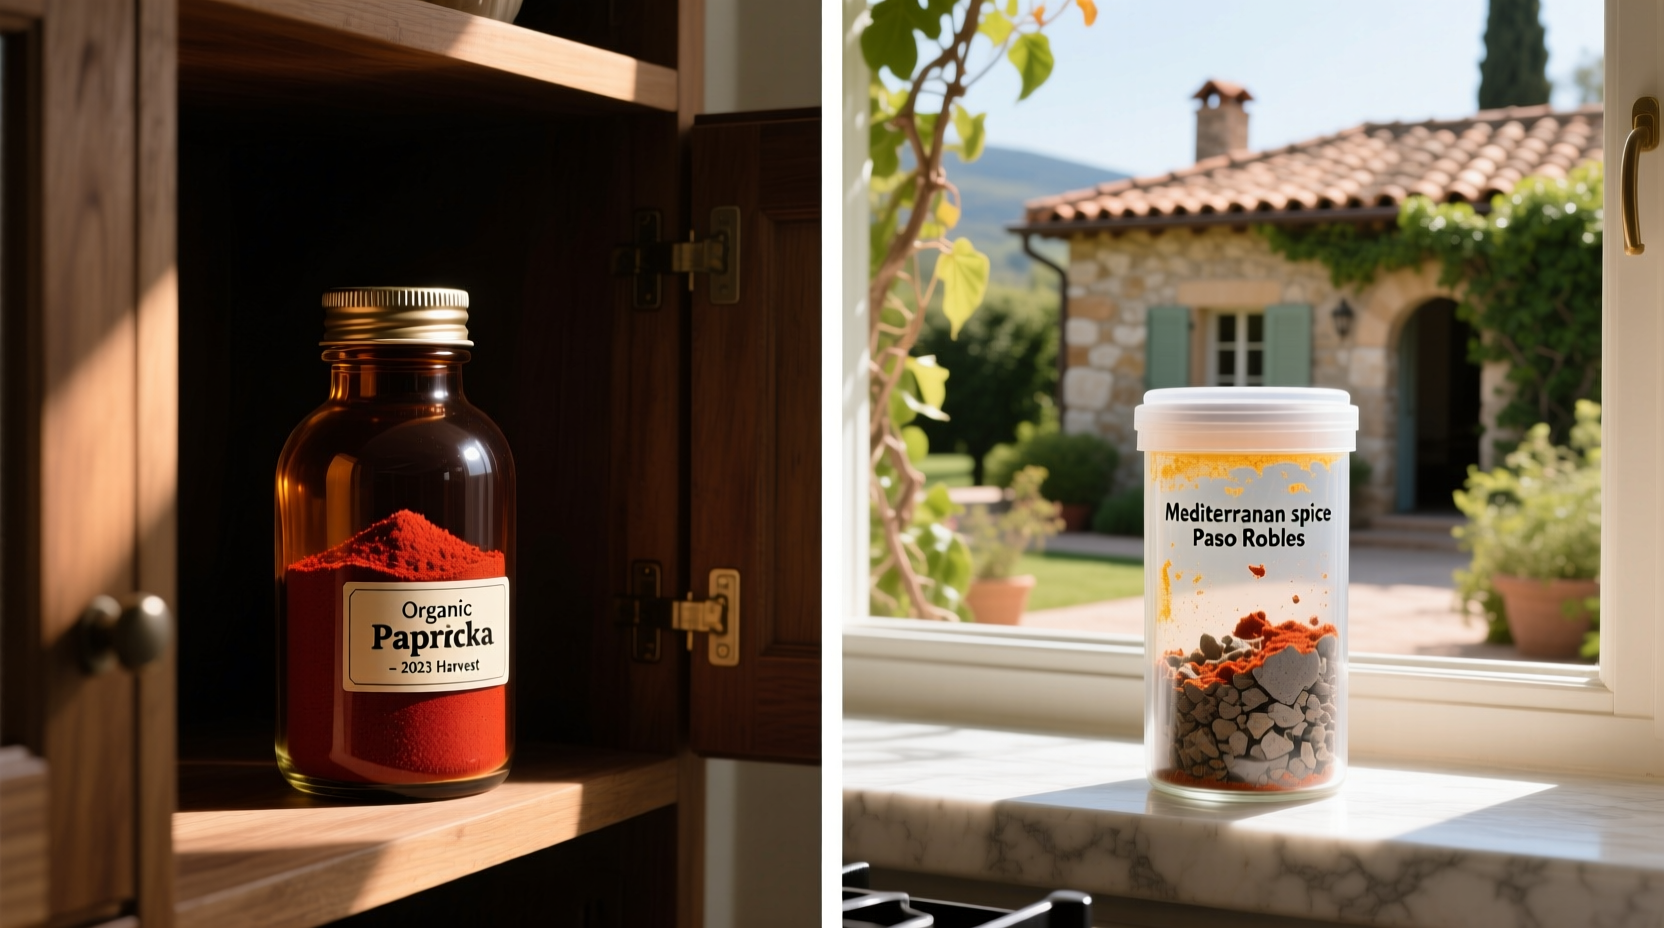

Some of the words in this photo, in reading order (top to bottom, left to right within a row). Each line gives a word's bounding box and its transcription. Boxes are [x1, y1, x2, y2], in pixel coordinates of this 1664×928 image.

[1165, 502, 1285, 523] Mediterranan
[1291, 503, 1332, 527] spice
[1193, 528, 1237, 547] Paso
[1242, 527, 1305, 547] Robles
[402, 599, 472, 624] Organic
[371, 620, 494, 657] Papricka
[401, 661, 432, 673] 2023
[436, 659, 480, 673] Harvest
